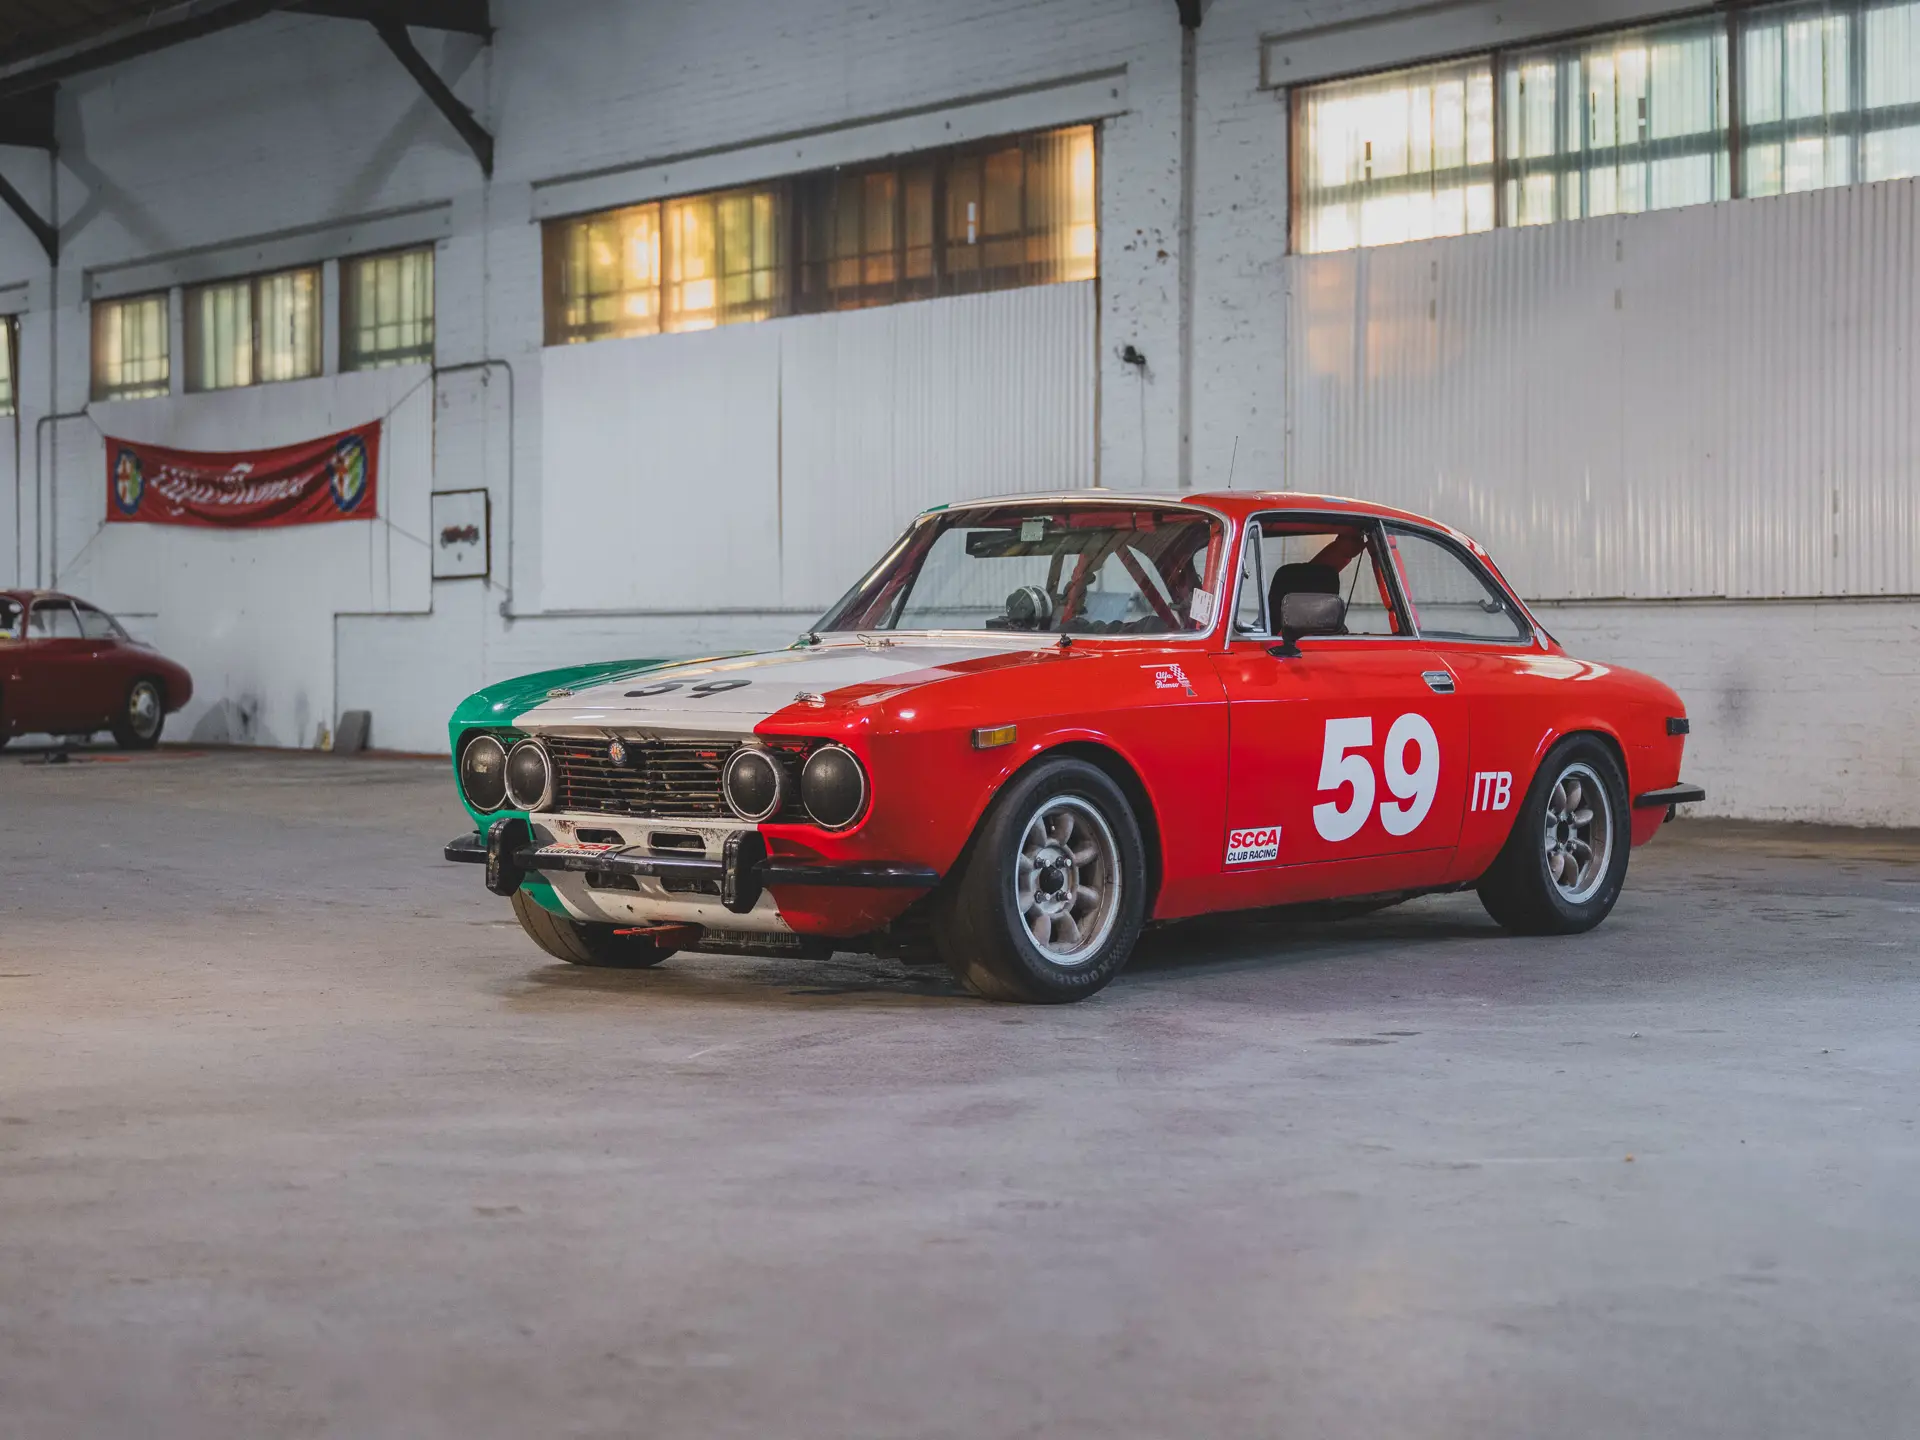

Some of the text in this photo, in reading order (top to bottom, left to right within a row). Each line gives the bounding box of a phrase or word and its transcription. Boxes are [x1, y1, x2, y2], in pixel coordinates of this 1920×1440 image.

[1155, 671, 1174, 682] Alfa
[624, 679, 752, 698] 59
[1313, 712, 1440, 842] 59
[1470, 771, 1512, 812] ITB
[1230, 829, 1277, 849] SCCA
[1227, 848, 1277, 862] CLUB RACING
